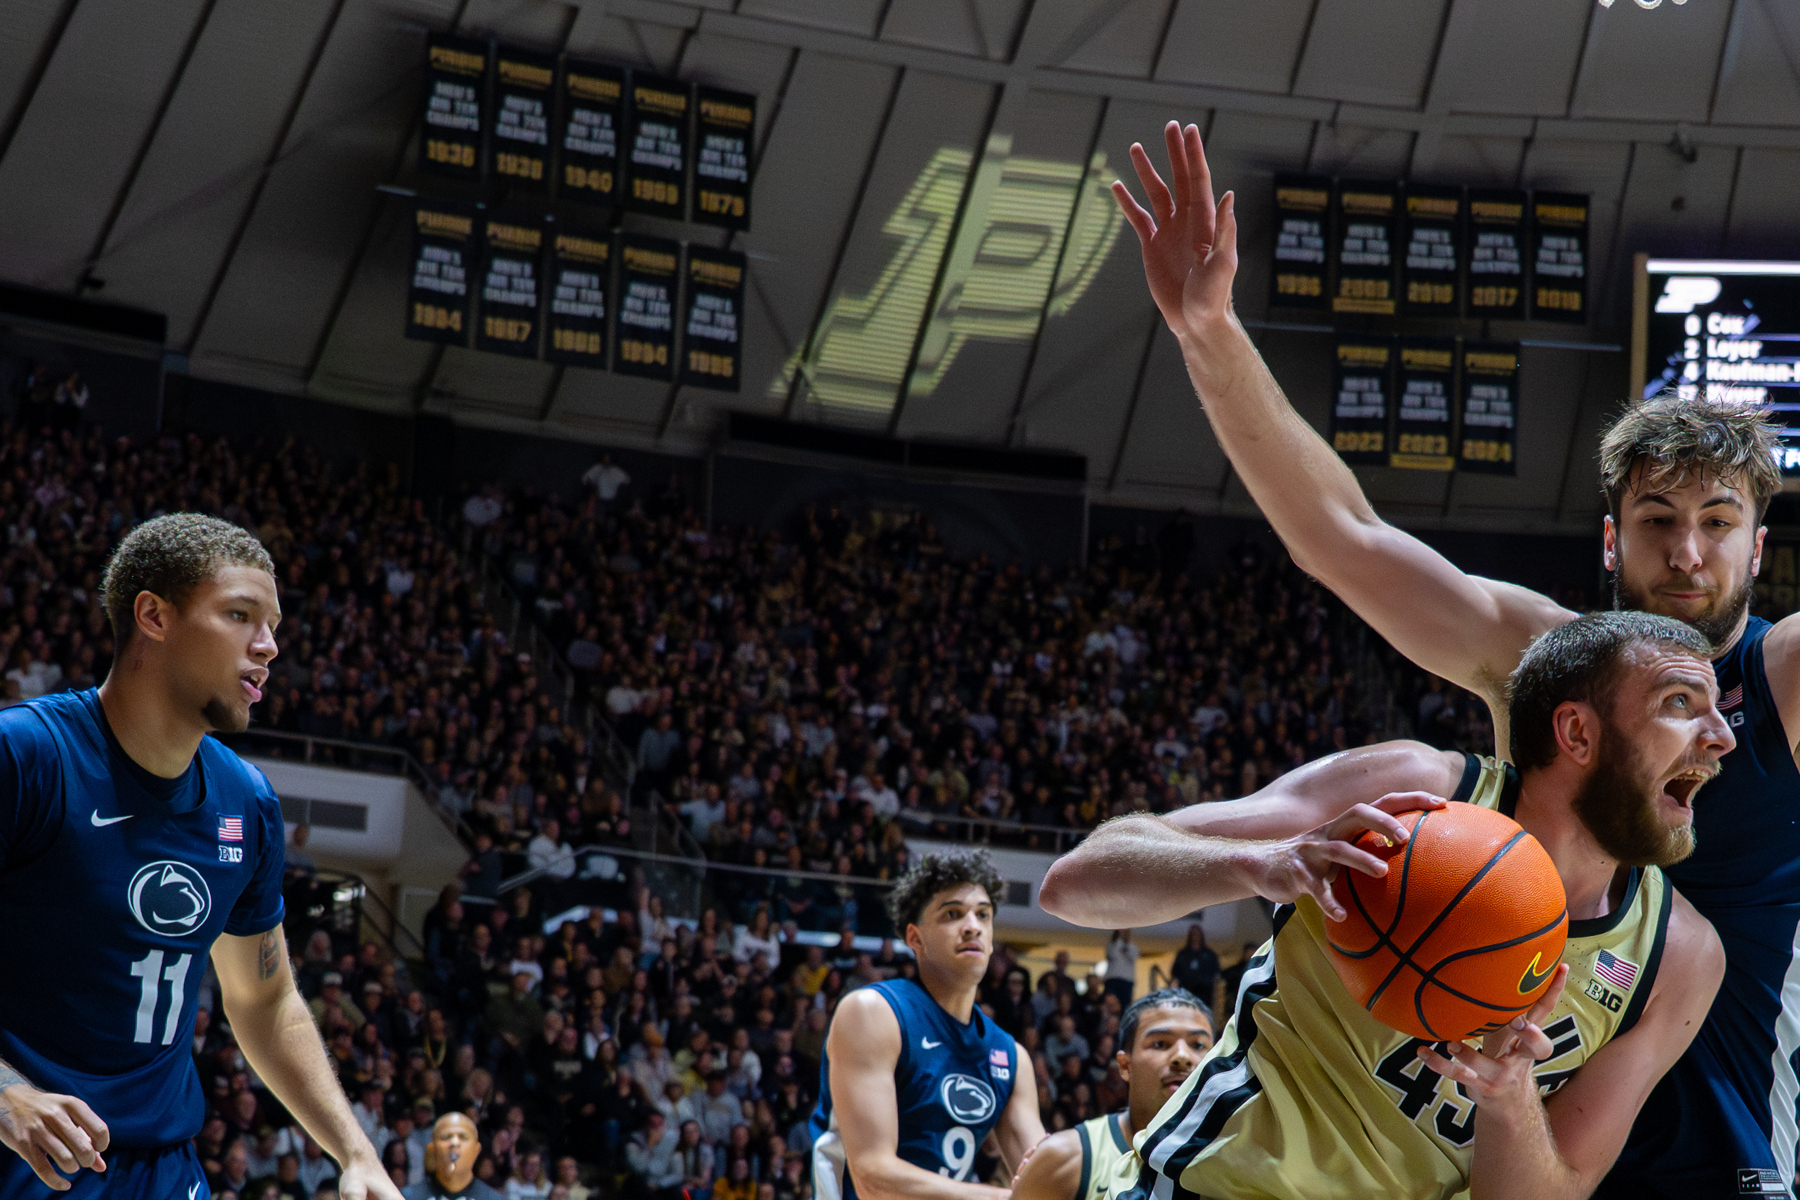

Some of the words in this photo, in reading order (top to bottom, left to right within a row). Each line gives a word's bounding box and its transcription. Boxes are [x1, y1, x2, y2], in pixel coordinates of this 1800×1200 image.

[1684, 338, 1700, 359] 2
[1706, 336, 1763, 362] Loyer
[1683, 360, 1699, 381] 4
[130, 949, 192, 1045] 11
[939, 1126, 975, 1181] 9
